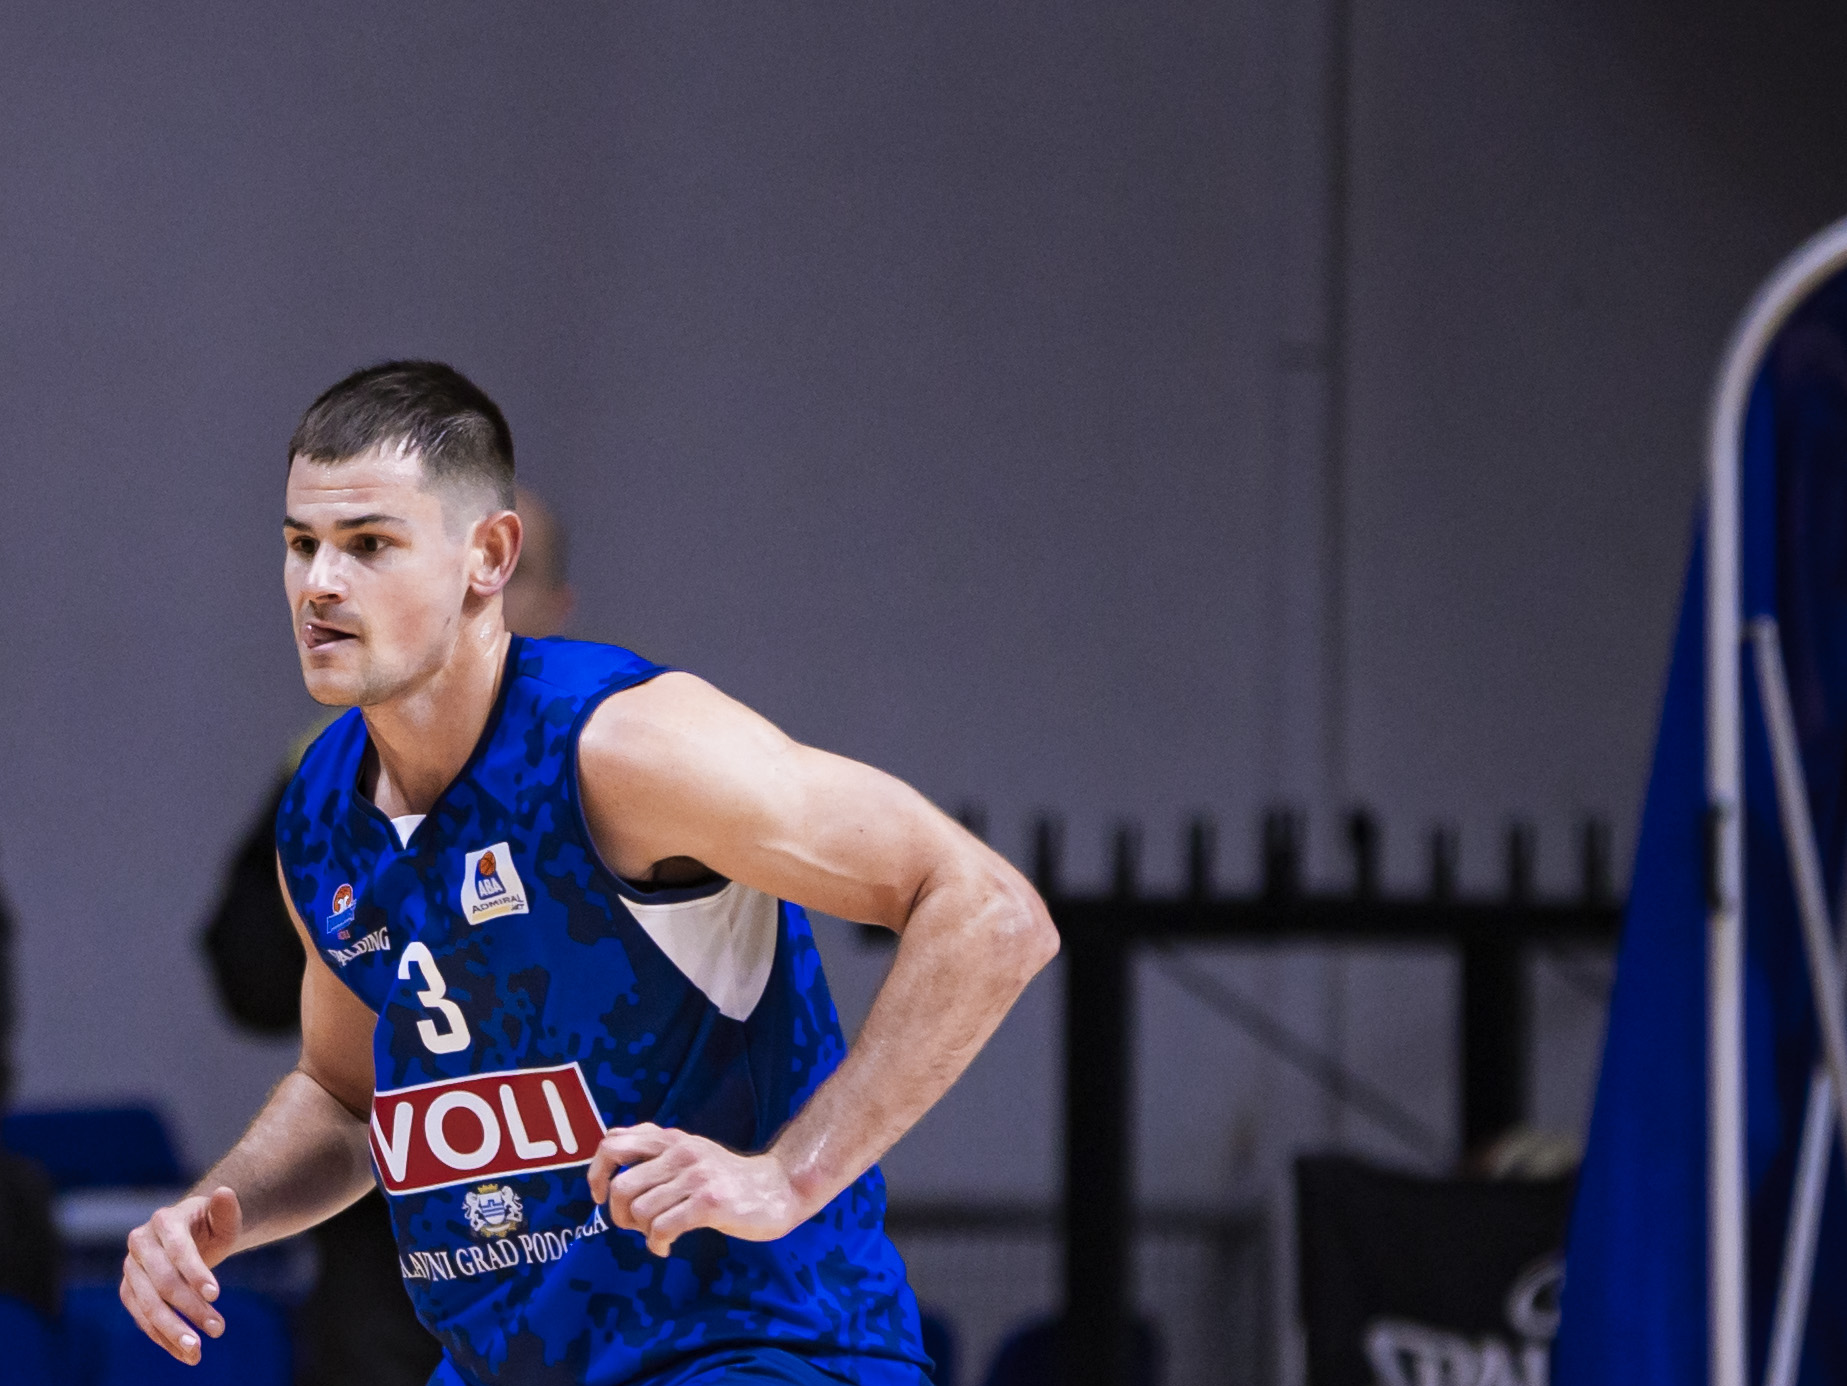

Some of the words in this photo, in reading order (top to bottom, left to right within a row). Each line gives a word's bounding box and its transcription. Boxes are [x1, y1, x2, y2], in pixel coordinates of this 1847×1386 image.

[472, 894, 524, 914] ADMIRAL
[478, 877, 504, 897] ABA
[327, 926, 391, 968] PALDING
[397, 941, 471, 1054] 3
[371, 1079, 579, 1183] VOLI
[455, 1239, 519, 1276] GRAD
